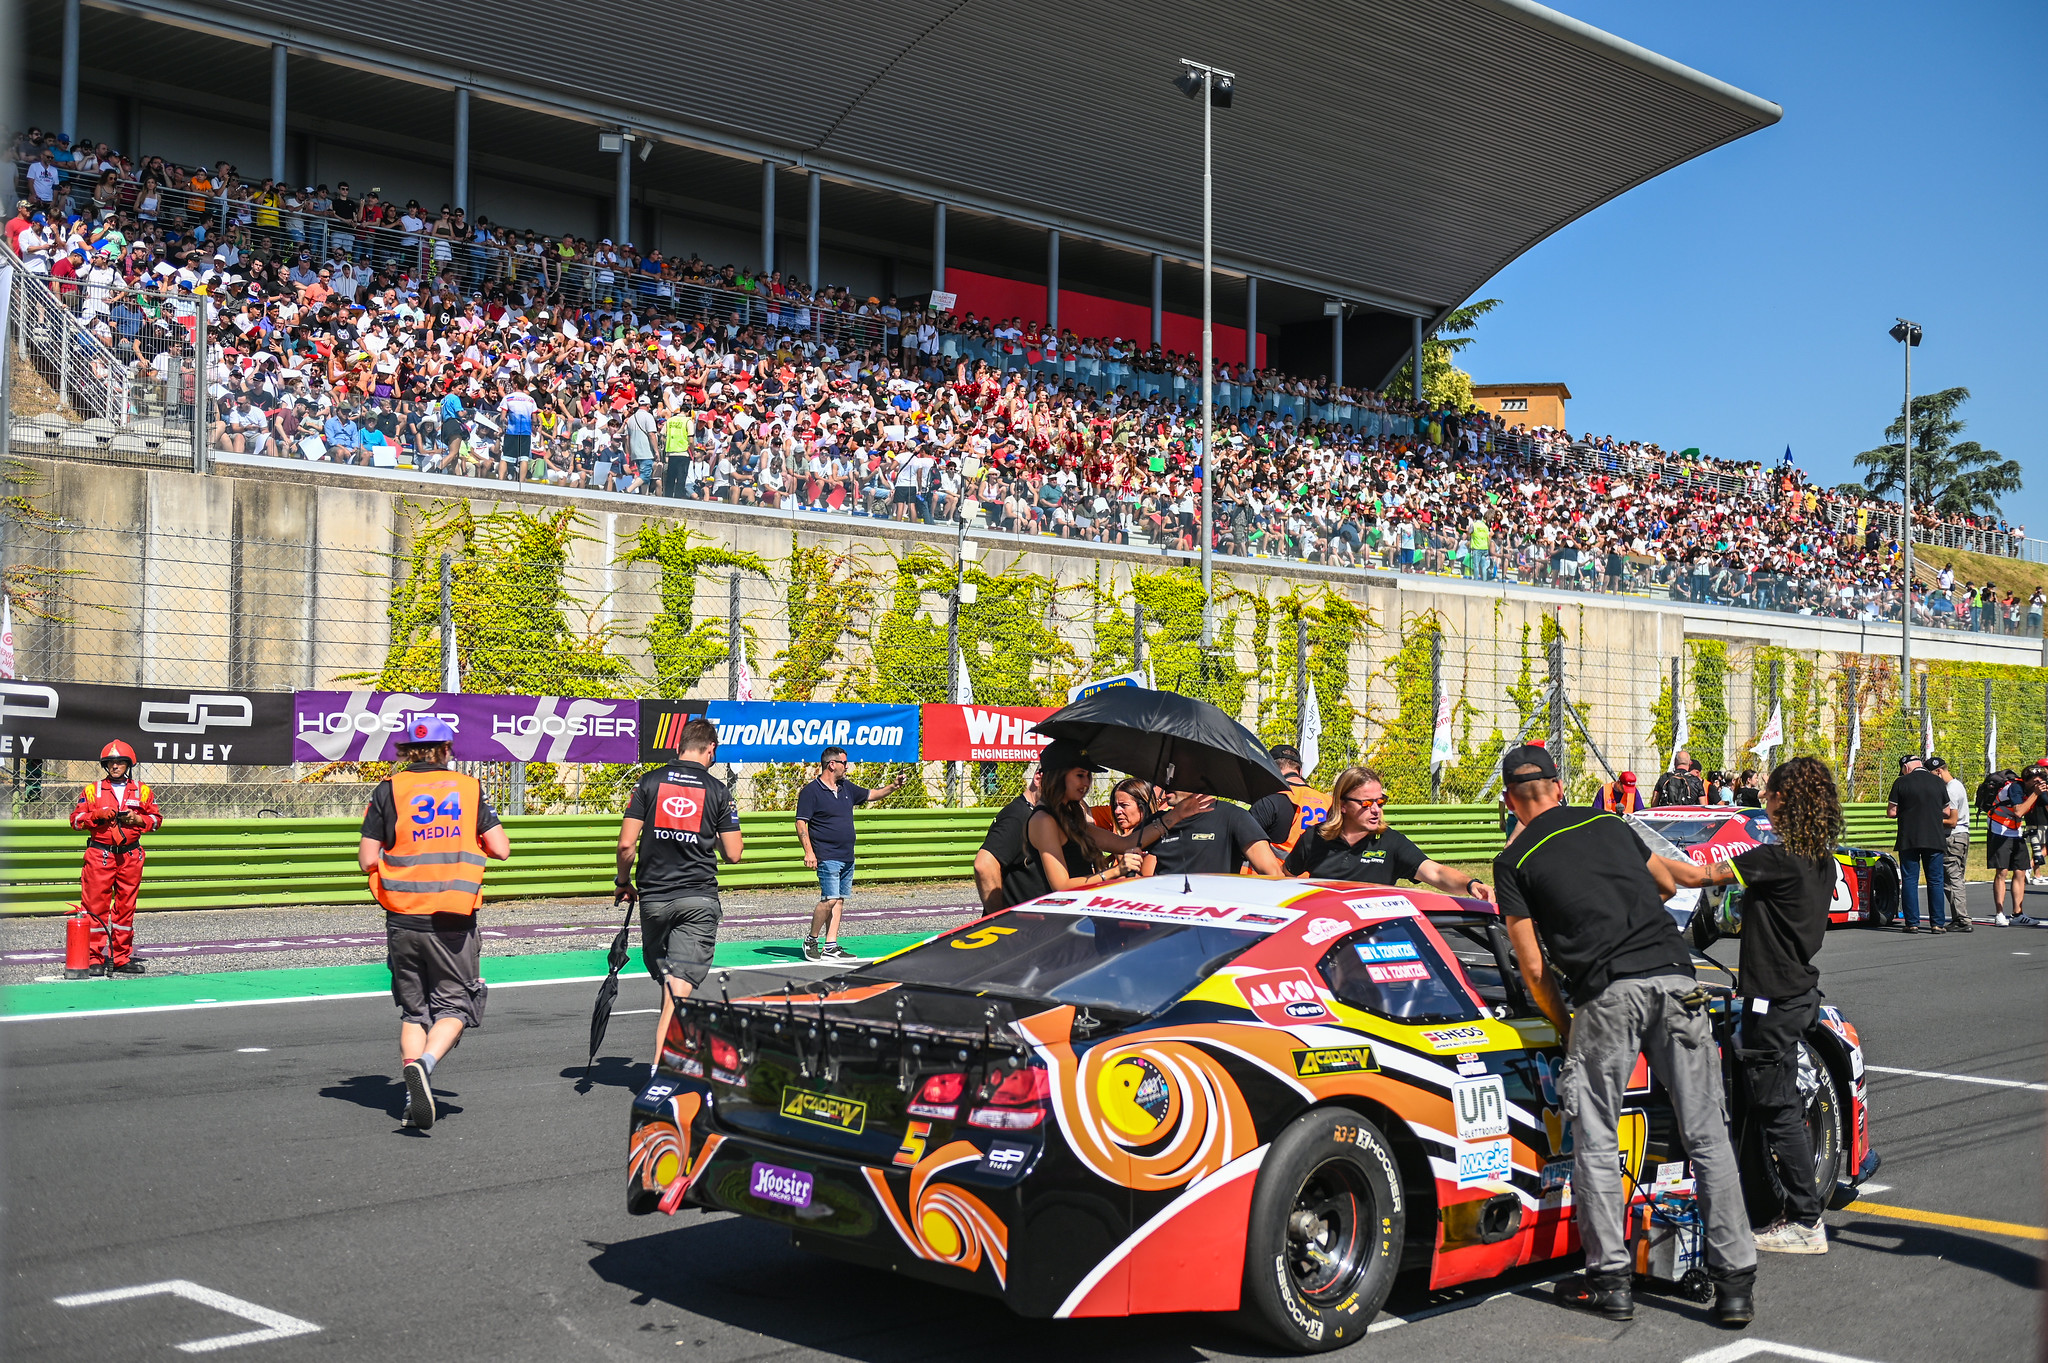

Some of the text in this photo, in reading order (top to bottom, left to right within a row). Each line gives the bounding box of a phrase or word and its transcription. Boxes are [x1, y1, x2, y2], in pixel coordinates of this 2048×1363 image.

[298, 712, 460, 734] HOOSIR
[493, 714, 636, 737] HOOSIER
[154, 742, 233, 761] TIJEY
[971, 749, 1038, 759] ENGINEERING
[411, 792, 461, 824] 34
[1301, 806, 1327, 829] 23
[412, 826, 461, 842] MEDIA
[654, 829, 698, 844] TOYOTA
[1086, 896, 1239, 919] WHELEN
[951, 926, 1018, 950] 5
[1250, 980, 1315, 1007] ALCO
[1495, 1005, 1507, 1020] 5
[1433, 1027, 1484, 1041] ENEOS
[1300, 1048, 1370, 1074] ACADEMY
[784, 1093, 862, 1127] ACADEMY
[1459, 1085, 1503, 1124] UM
[1464, 1126, 1503, 1139] ELETTRONICA
[892, 1121, 932, 1168] 5
[754, 1168, 811, 1198] Hoosier
[1368, 1138, 1401, 1213] HOOSIER
[1487, 1171, 1500, 1181] PACK
[769, 1190, 792, 1201] RACING
[1276, 1255, 1311, 1331] HOOSIER
